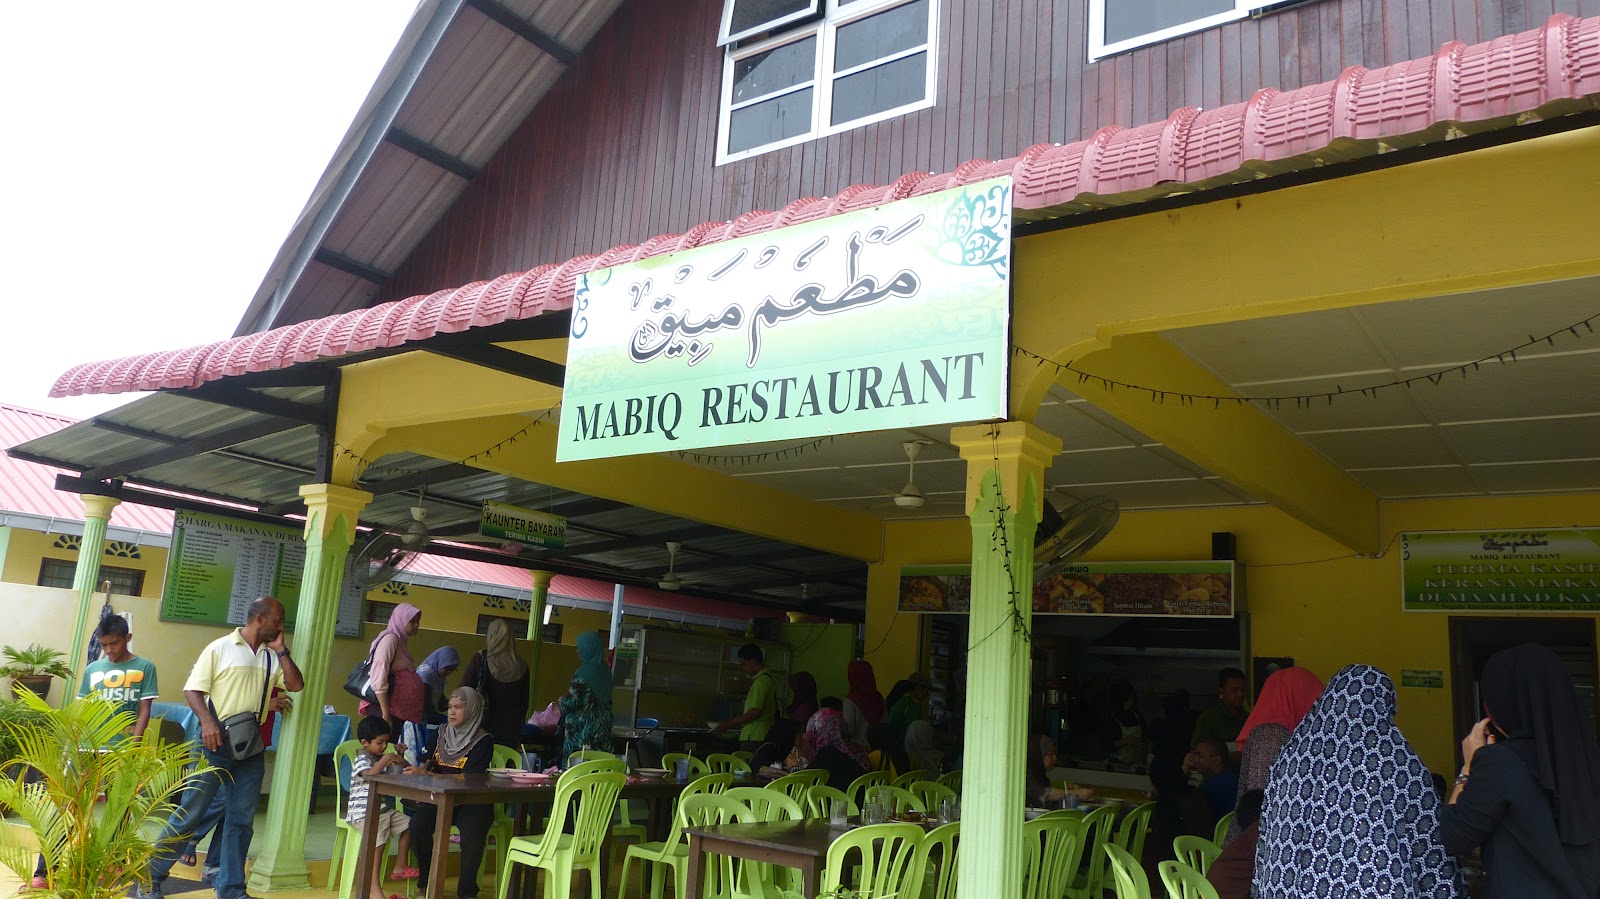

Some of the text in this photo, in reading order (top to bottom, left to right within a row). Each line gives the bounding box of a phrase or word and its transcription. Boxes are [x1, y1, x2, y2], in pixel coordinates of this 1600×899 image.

[573, 352, 985, 442] MABIQ RESTAURANT
[185, 516, 221, 530] HARGA
[224, 522, 273, 538] MAKANAN
[275, 531, 285, 540] DI
[486, 512, 564, 538] KAUNTER BAYARAN
[504, 531, 545, 544] TERIMA KASIH
[1433, 564, 1523, 574] TERIMA
[1424, 578, 1519, 588] KERANA
[1418, 592, 1440, 602] DI
[90, 669, 145, 692] POP
